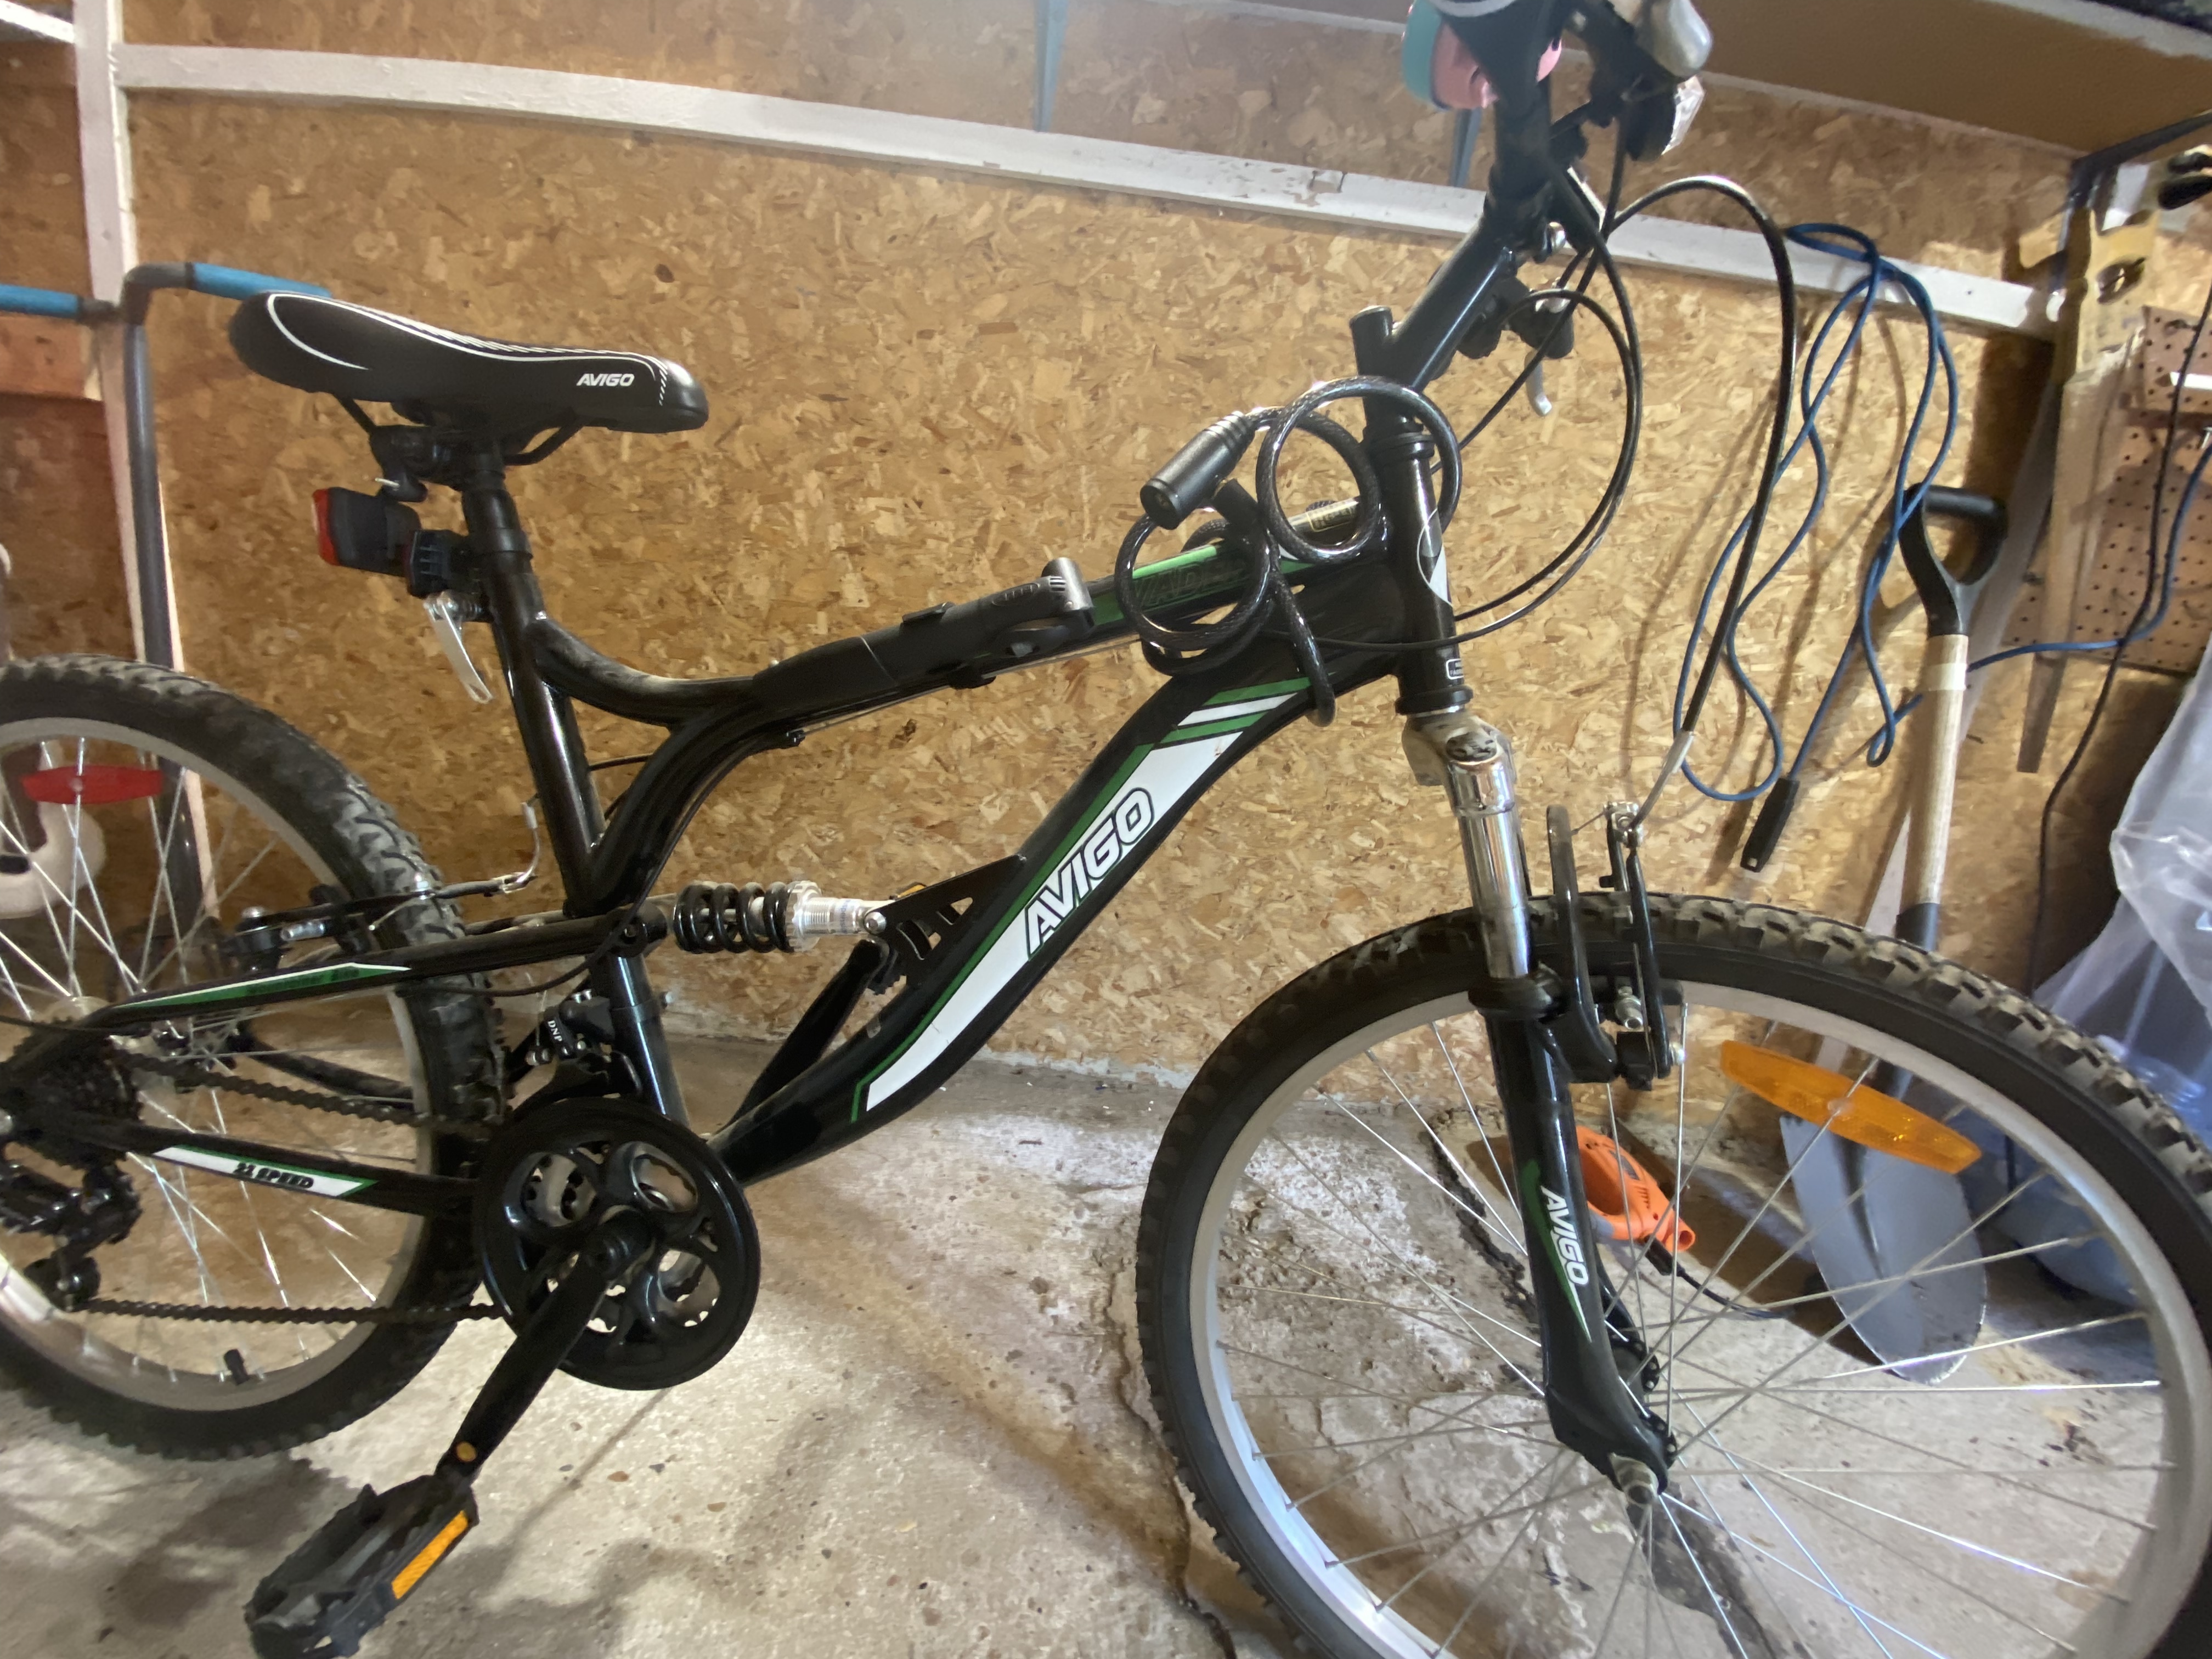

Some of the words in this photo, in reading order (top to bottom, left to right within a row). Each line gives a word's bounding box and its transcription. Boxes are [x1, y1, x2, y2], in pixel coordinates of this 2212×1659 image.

[576, 374, 635, 386] AVIGO
[1025, 787, 1155, 961] AVIGO
[548, 1020, 562, 1041] DNP
[1540, 1184, 1589, 1286] AVIGO
